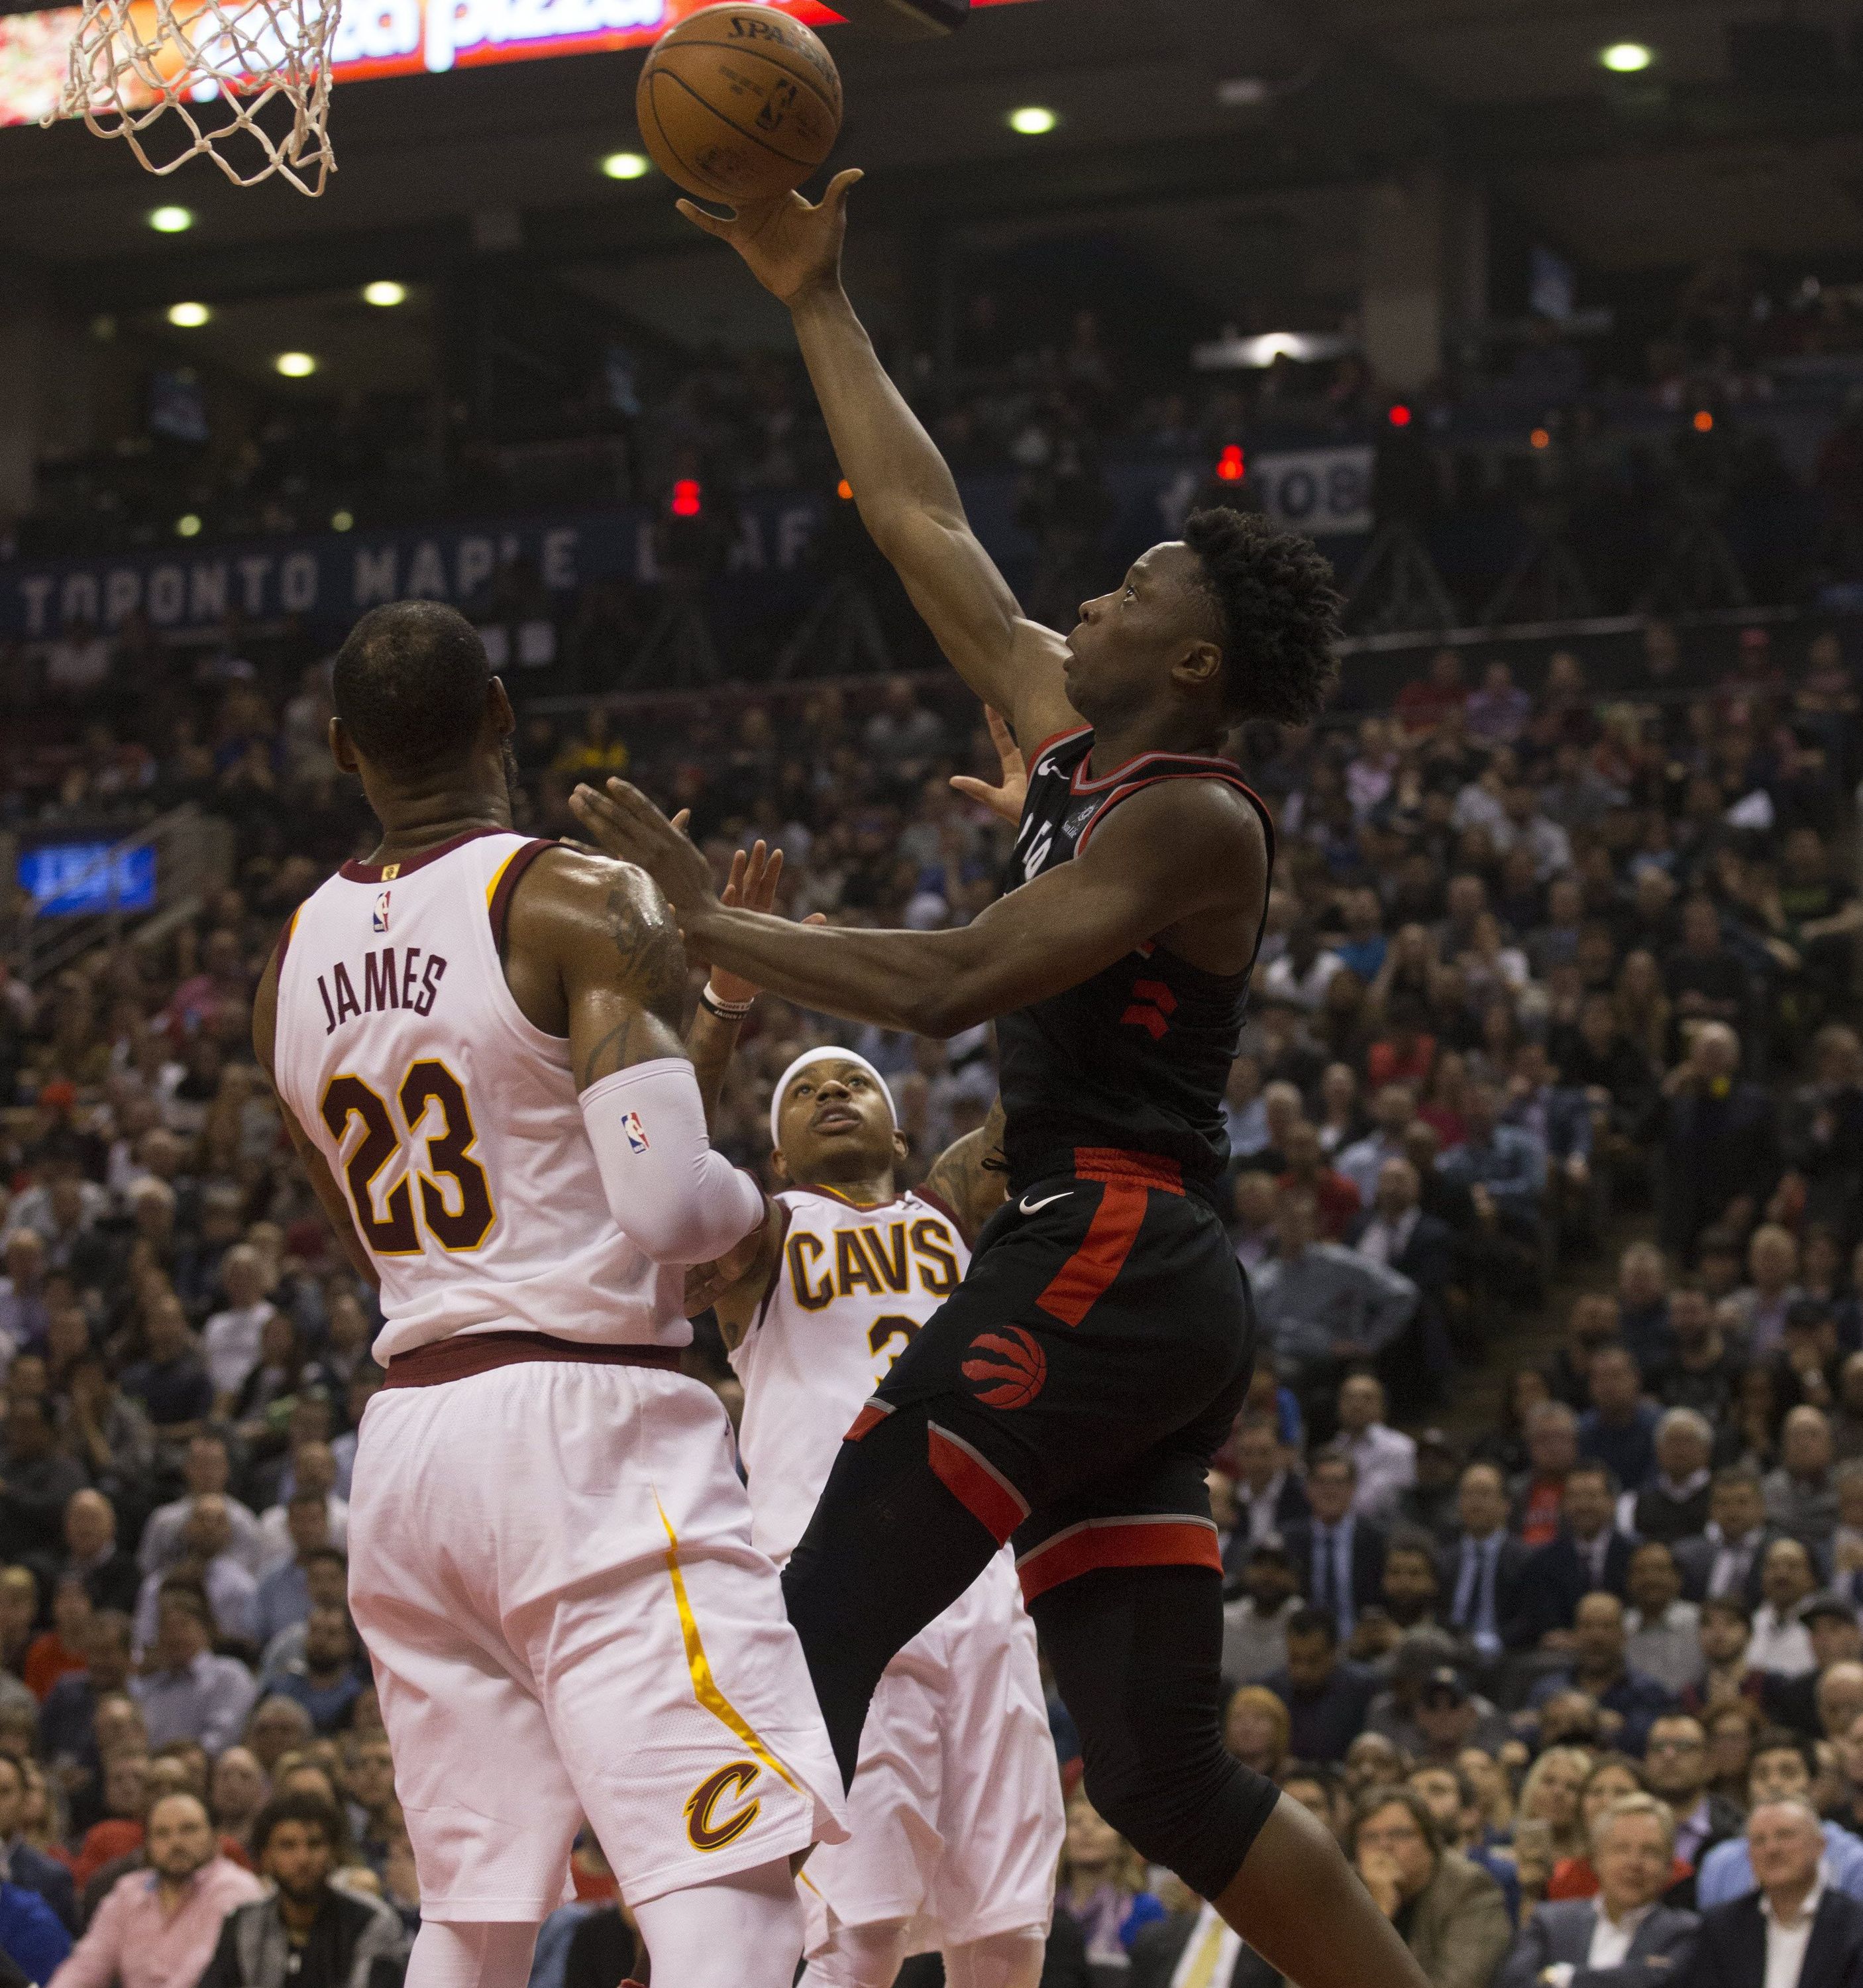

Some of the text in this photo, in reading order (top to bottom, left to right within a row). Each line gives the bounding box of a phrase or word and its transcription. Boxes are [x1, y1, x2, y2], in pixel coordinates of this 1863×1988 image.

[1254, 464, 1361, 520] 08
[20, 551, 319, 634] TORONTO
[352, 527, 578, 606] MAPE
[317, 947, 447, 1036] JAMES
[320, 1058, 497, 1256] 23
[784, 1217, 962, 1314] CAVS
[682, 1760, 761, 1853] C
